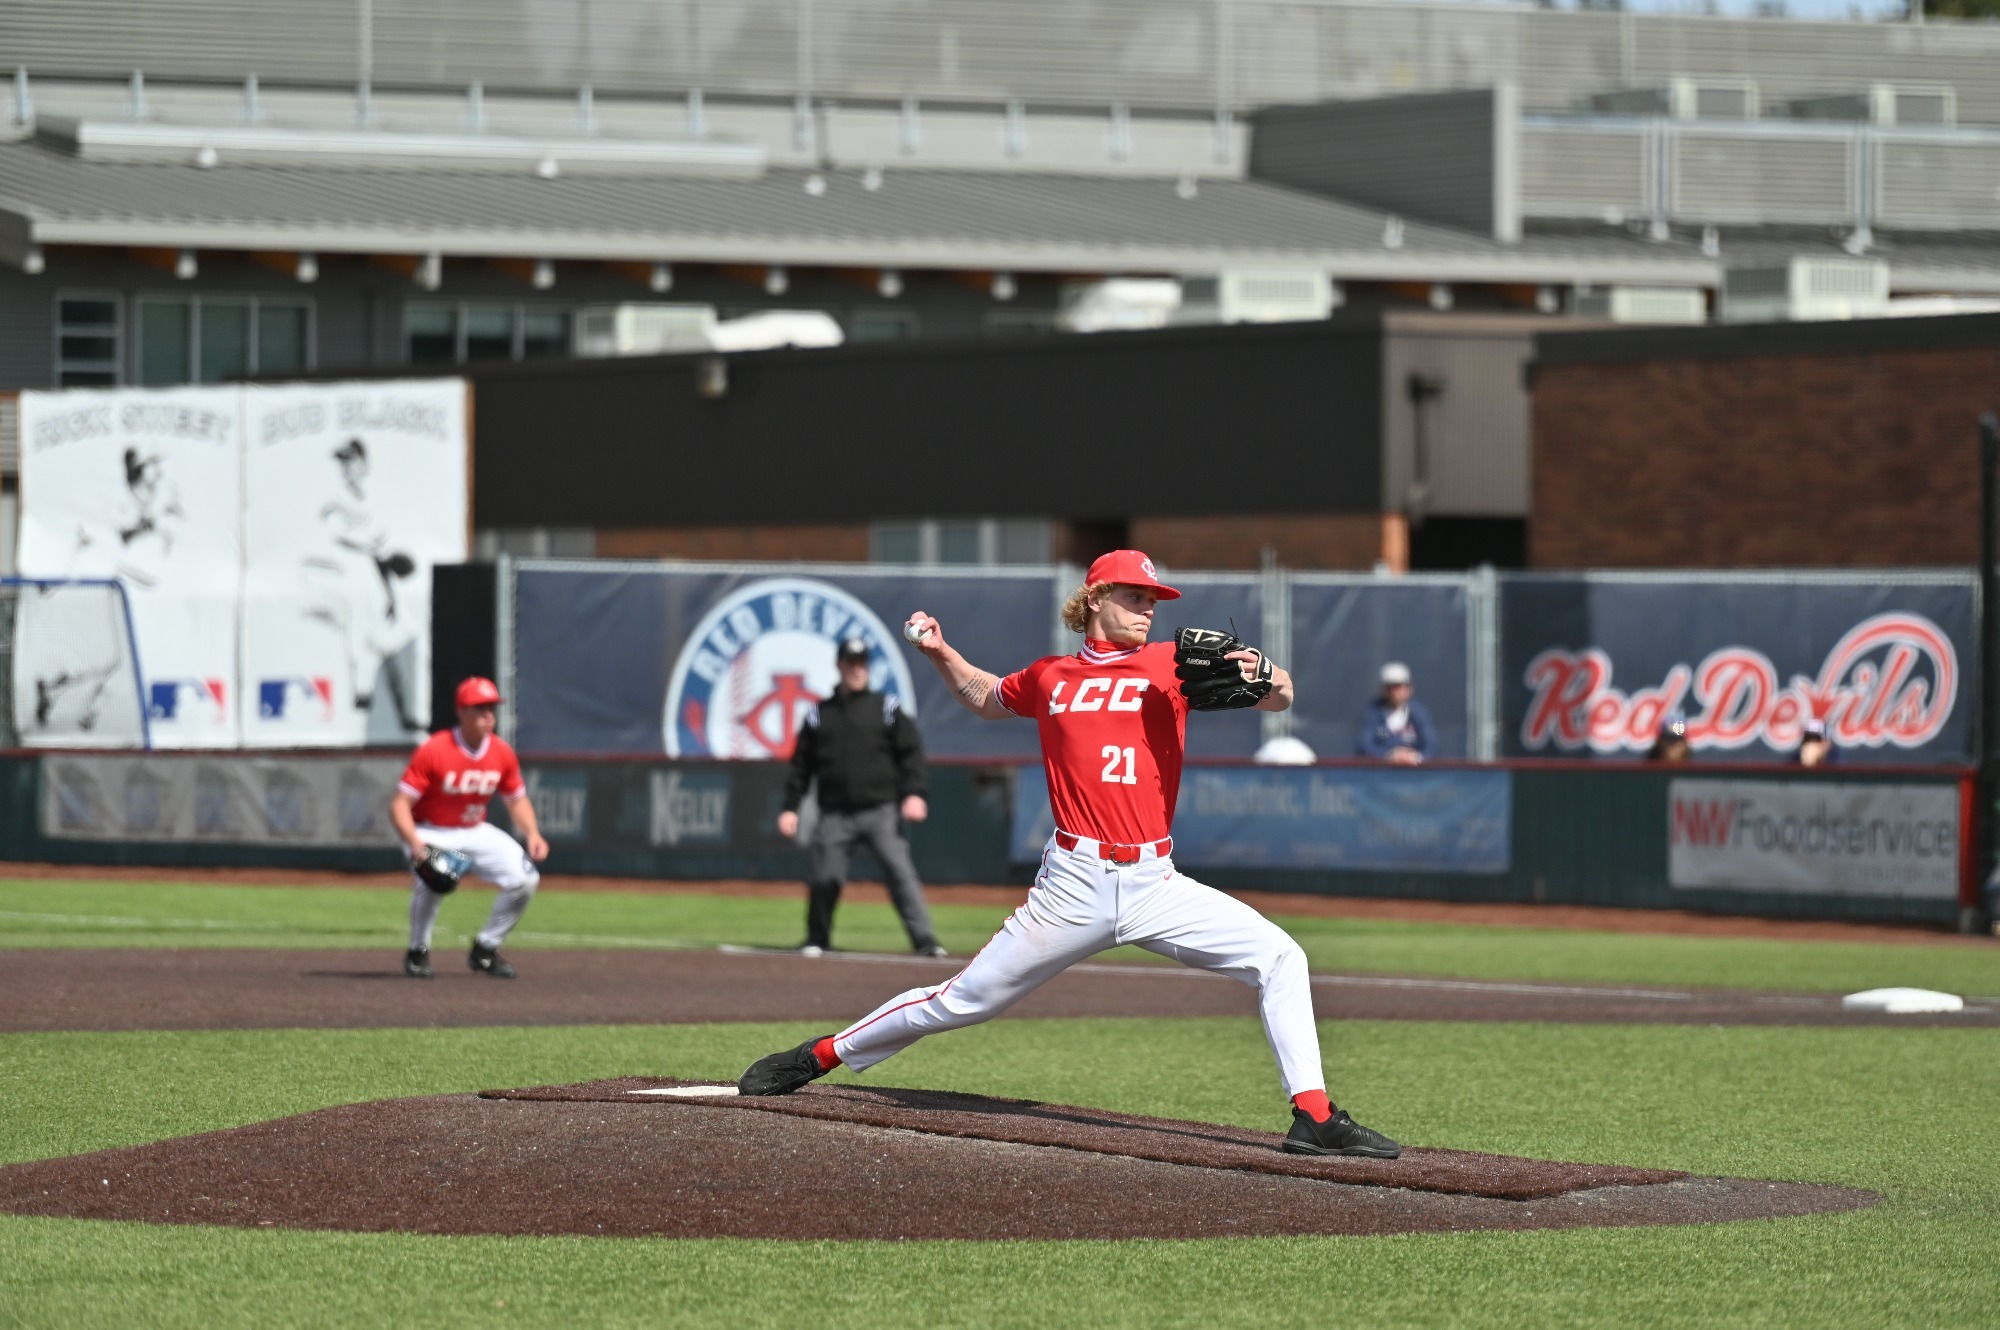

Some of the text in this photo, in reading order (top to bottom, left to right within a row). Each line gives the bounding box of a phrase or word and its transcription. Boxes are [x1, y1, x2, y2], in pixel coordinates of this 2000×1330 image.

[692, 603, 763, 685] RED
[1049, 677, 1151, 716] LCC
[1522, 610, 1959, 753] Red Devils
[441, 769, 502, 795] LCC
[1101, 744, 1138, 785] 21
